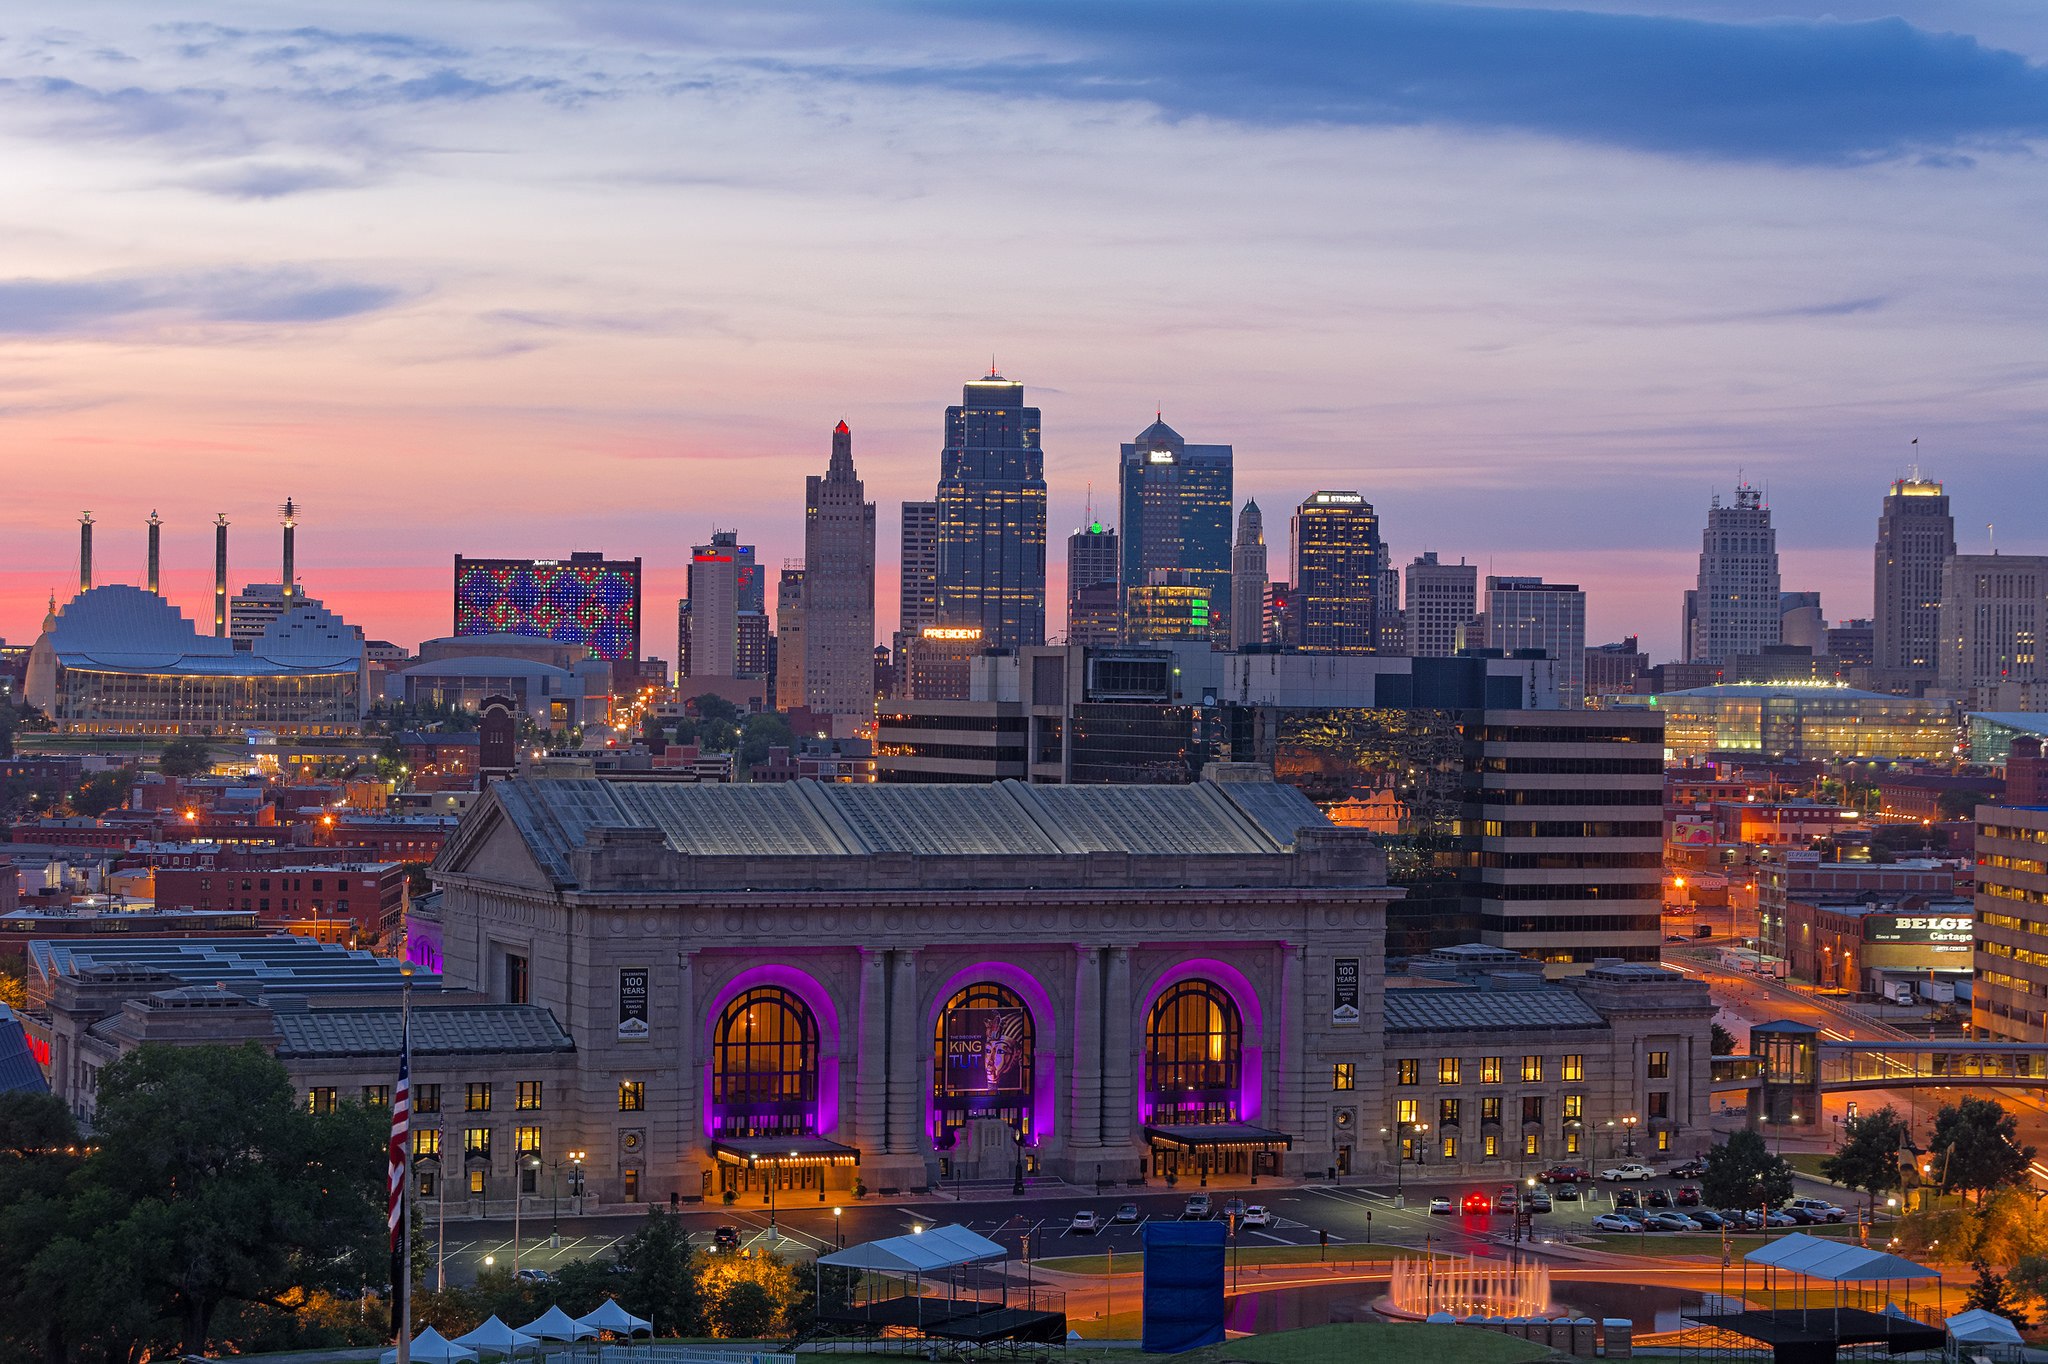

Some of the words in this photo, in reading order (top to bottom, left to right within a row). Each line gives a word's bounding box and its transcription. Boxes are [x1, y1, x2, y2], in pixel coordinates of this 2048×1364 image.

[923, 628, 982, 639] PRESIDENT
[1930, 932, 1973, 942] Cartage
[1339, 967, 1354, 975] 100
[625, 977, 643, 986] 100
[949, 1054, 982, 1069] TUT
